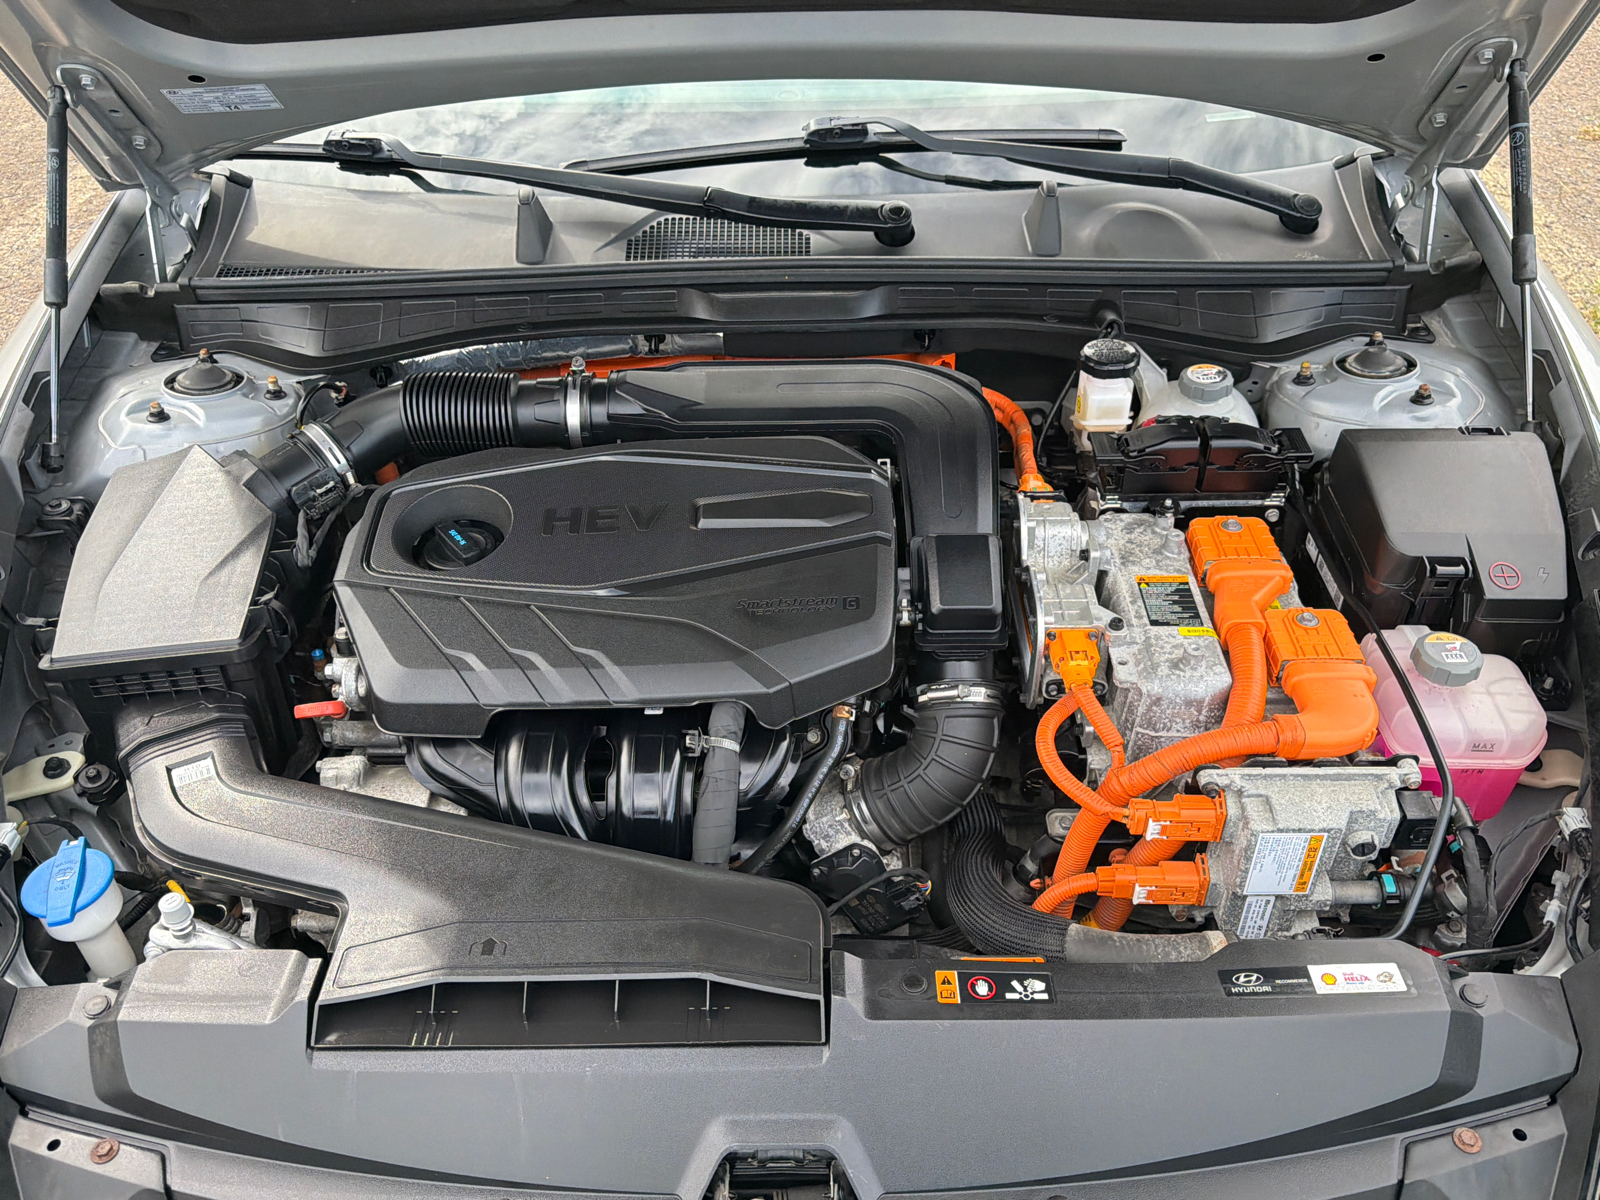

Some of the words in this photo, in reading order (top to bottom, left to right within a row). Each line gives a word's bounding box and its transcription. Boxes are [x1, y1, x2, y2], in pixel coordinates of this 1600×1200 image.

[541, 502, 670, 536] HEV
[735, 596, 838, 609] Smartstream
[748, 605, 836, 616] TECHNOLOGY
[1231, 985, 1272, 993] HYUNDAI
